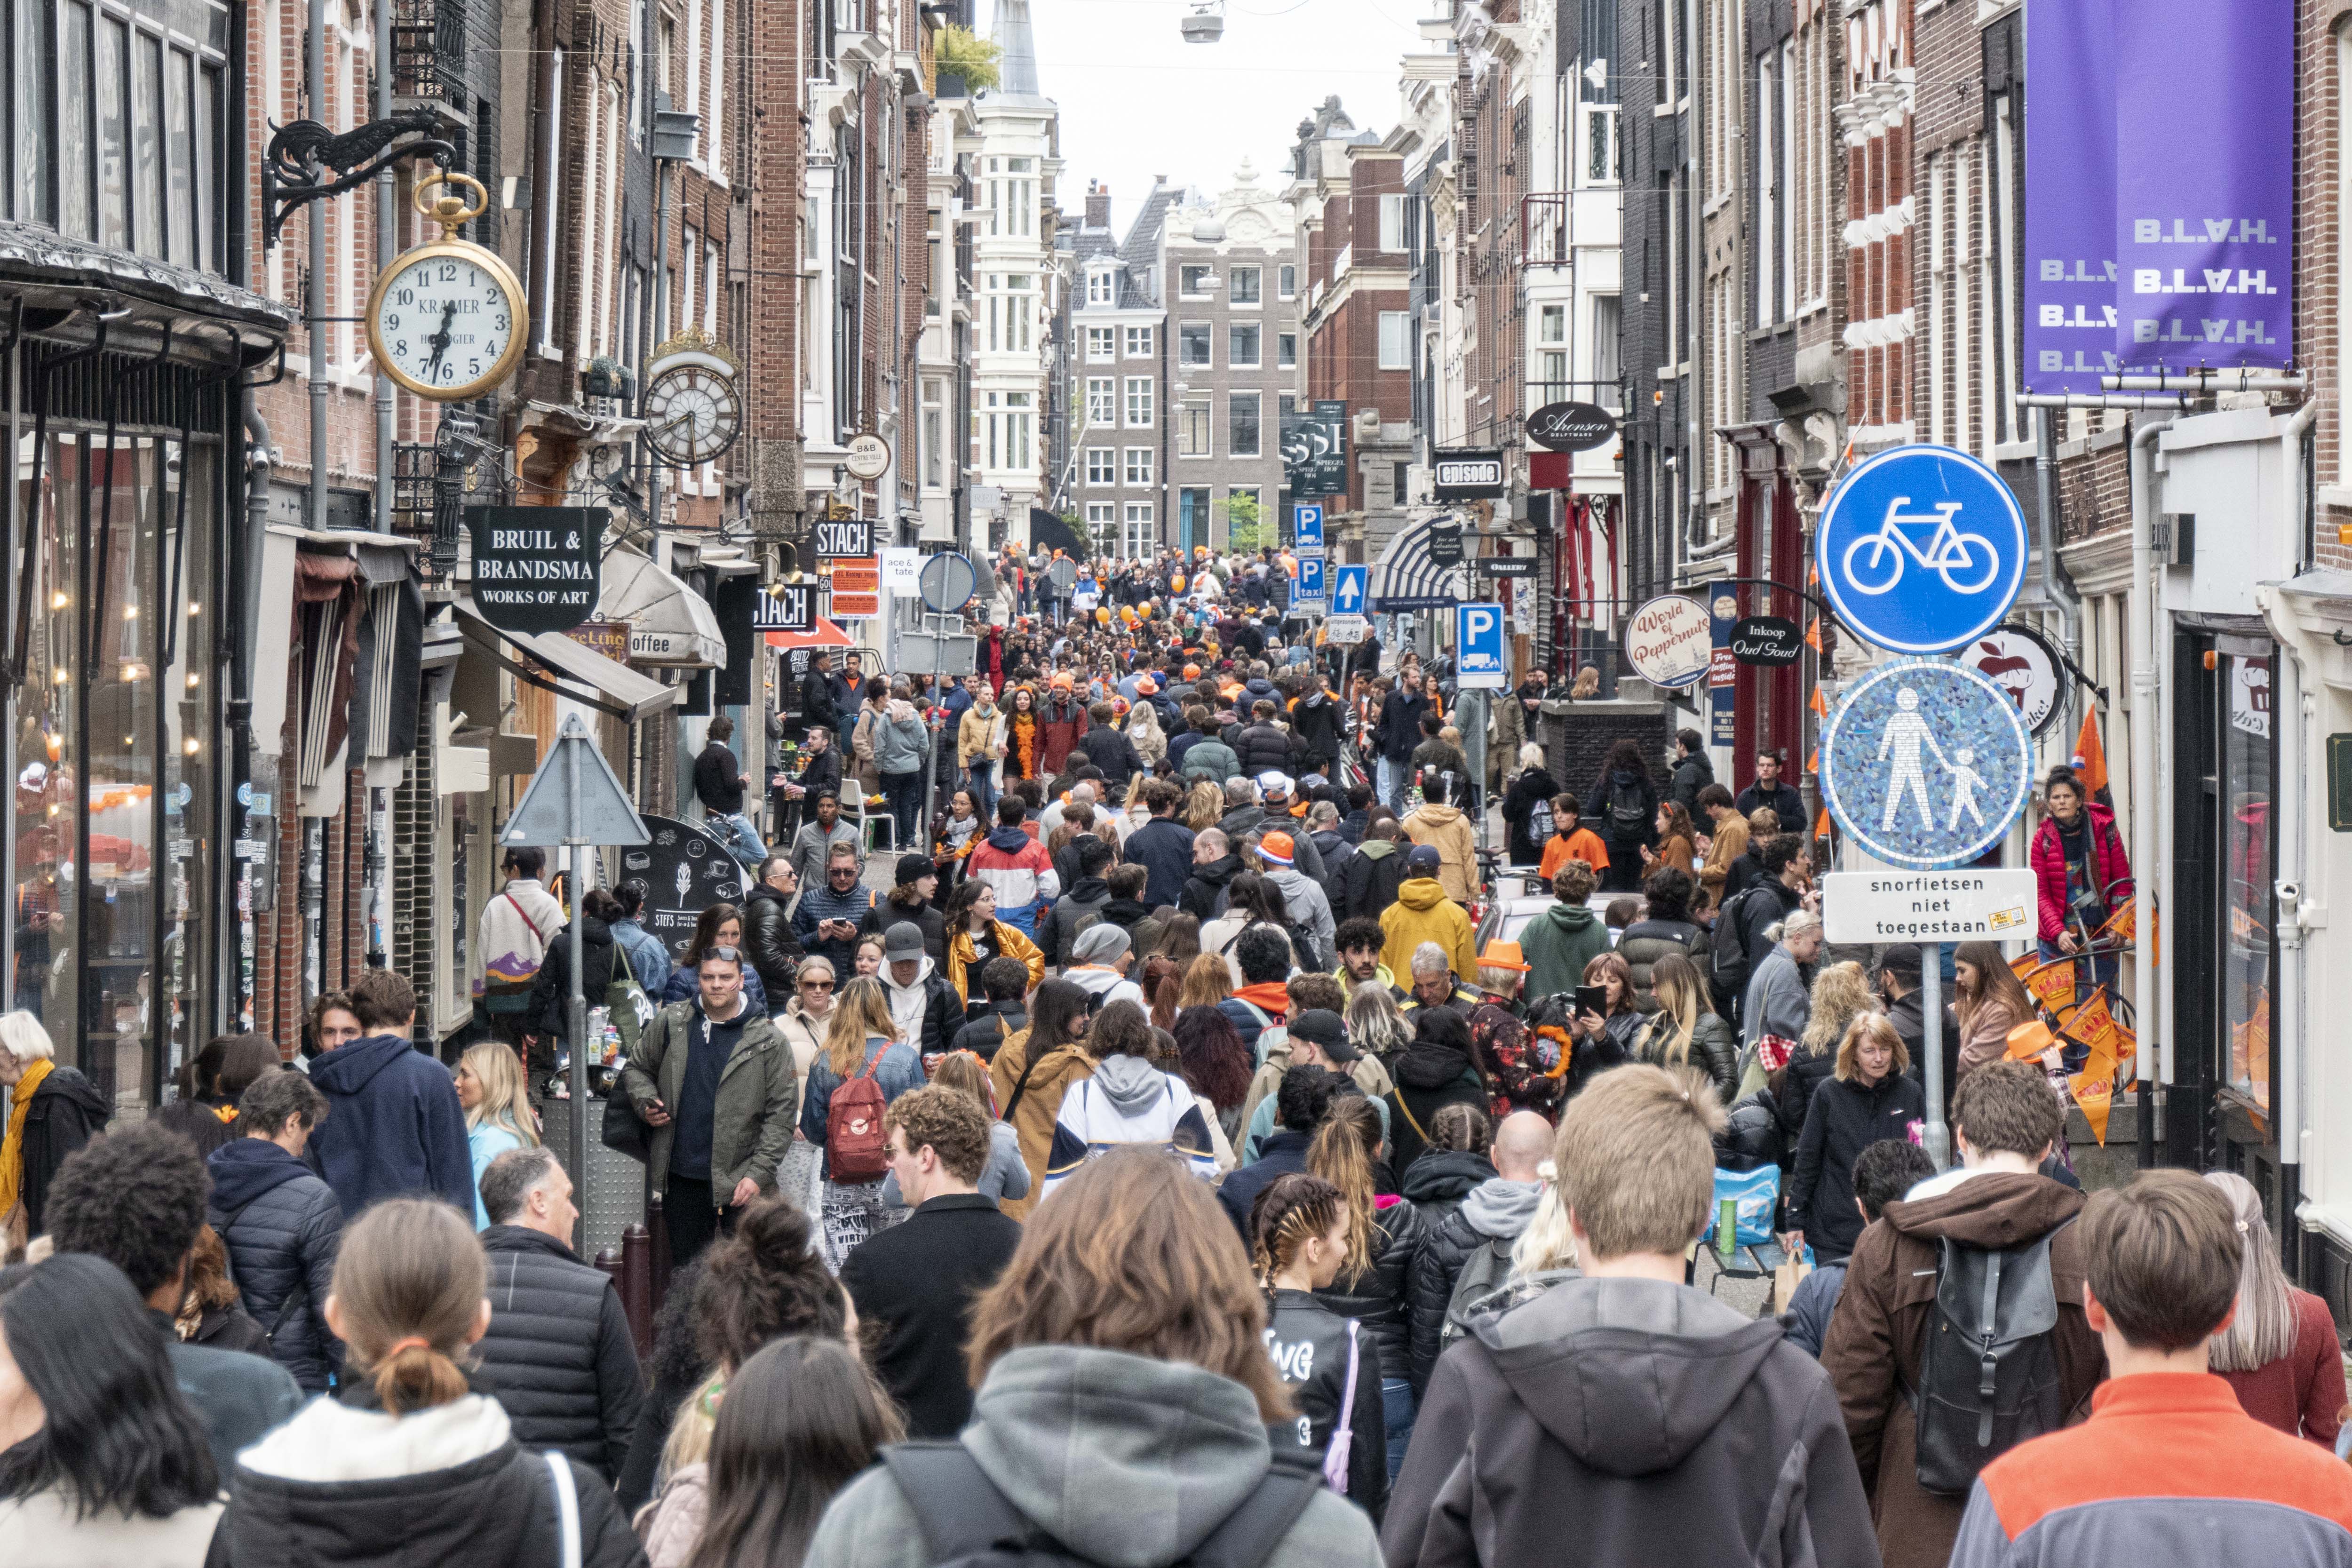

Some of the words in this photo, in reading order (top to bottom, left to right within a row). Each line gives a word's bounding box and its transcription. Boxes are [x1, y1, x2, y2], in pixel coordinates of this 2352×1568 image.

[417, 271, 430, 287] 11
[438, 265, 456, 281] 12
[469, 271, 475, 287] 1
[397, 288, 413, 305] 10
[486, 288, 497, 305] 2
[389, 314, 399, 330] 9
[495, 314, 506, 331] 3
[396, 340, 407, 356] 8
[485, 340, 496, 356] 4
[419, 358, 429, 374] 7
[442, 363, 453, 379] 6
[469, 358, 480, 374] 5
[1534, 409, 1608, 435] Aronson
[1442, 464, 1495, 483] episode
[1301, 509, 1317, 531] P
[492, 530, 556, 549] BRUIL
[566, 531, 580, 549] &
[817, 524, 867, 553] STACH
[478, 560, 594, 580] BRANDSMA
[1303, 562, 1319, 582] P
[482, 590, 534, 603] WORKS
[538, 591, 557, 604] OF
[560, 592, 589, 604] ART
[1301, 588, 1322, 597] taxi
[1638, 602, 1684, 633] World
[1468, 611, 1494, 645] P
[1661, 622, 1673, 636] of
[1750, 625, 1786, 639] Inkoop
[1634, 617, 1710, 664] Peppernuts
[790, 650, 810, 662] SAND
[1733, 640, 1761, 655] Oud
[1763, 643, 1800, 658] Goud
[1715, 653, 1732, 662] Free
[1672, 673, 1698, 685] AMSTERDAM
[1871, 877, 1984, 891] snorfietsen
[1912, 899, 1950, 912] niet
[655, 915, 674, 927] STEFS
[1876, 920, 1986, 938] toegestaan
